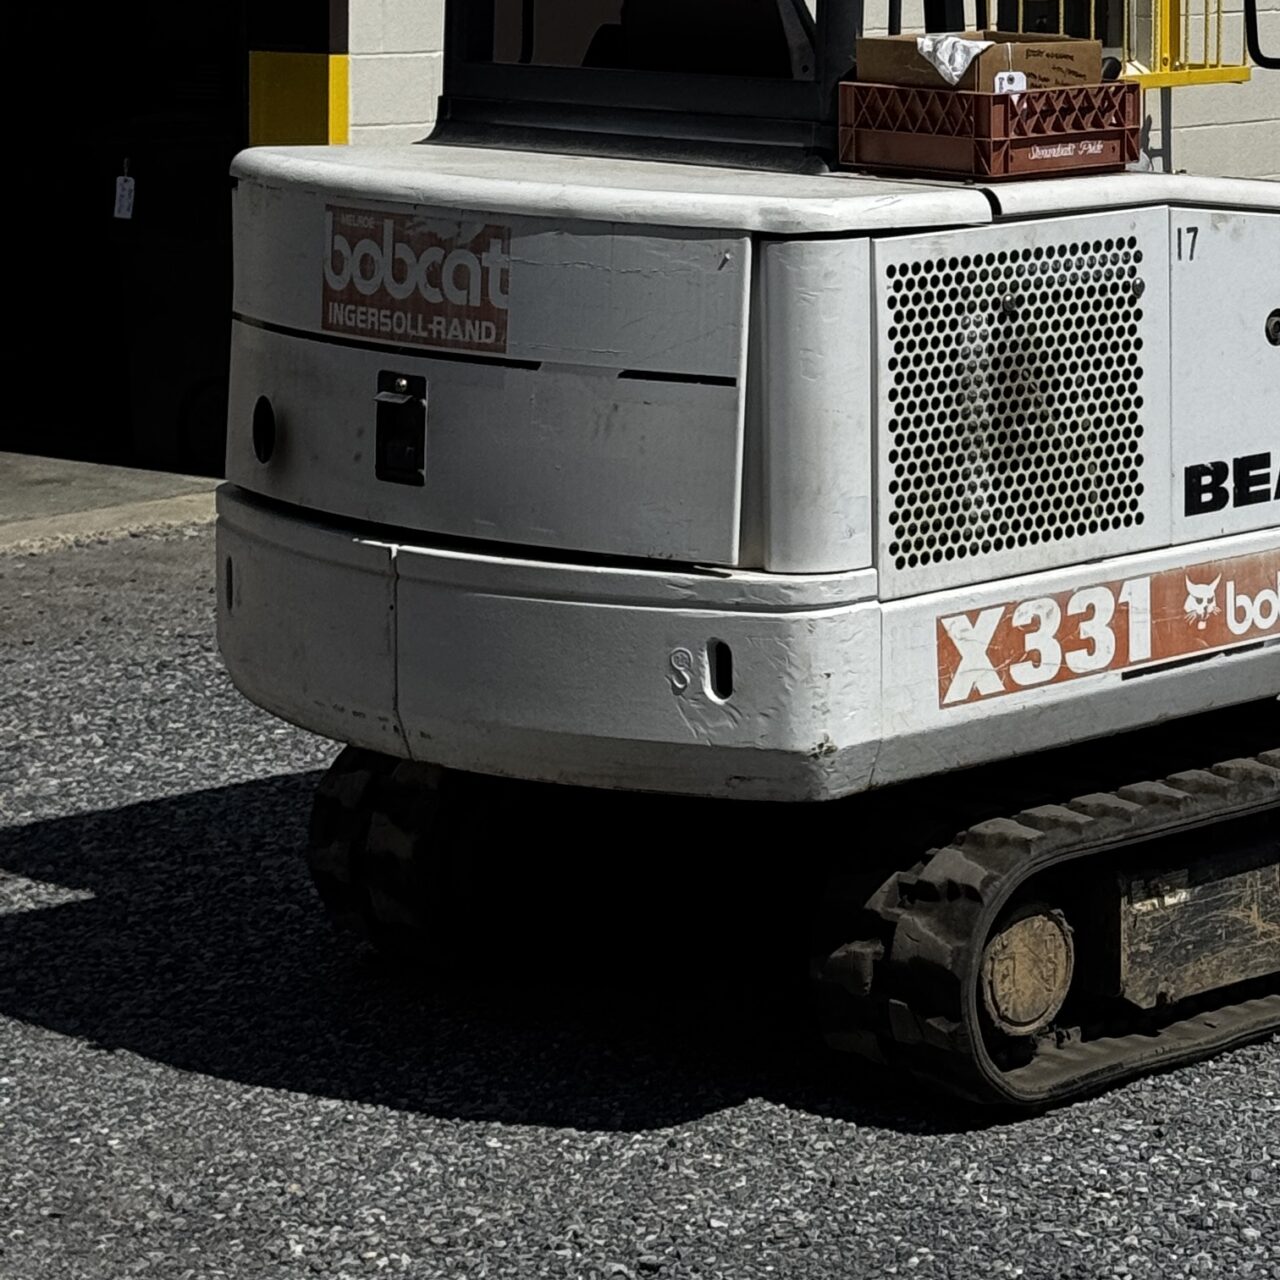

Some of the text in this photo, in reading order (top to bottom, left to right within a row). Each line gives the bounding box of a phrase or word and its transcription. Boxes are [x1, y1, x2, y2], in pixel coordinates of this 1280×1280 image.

[324, 210, 509, 309] bobcat
[1177, 226, 1199, 261] 17
[328, 301, 497, 344] INGERSOLL-RAND
[941, 576, 1151, 704] X331
